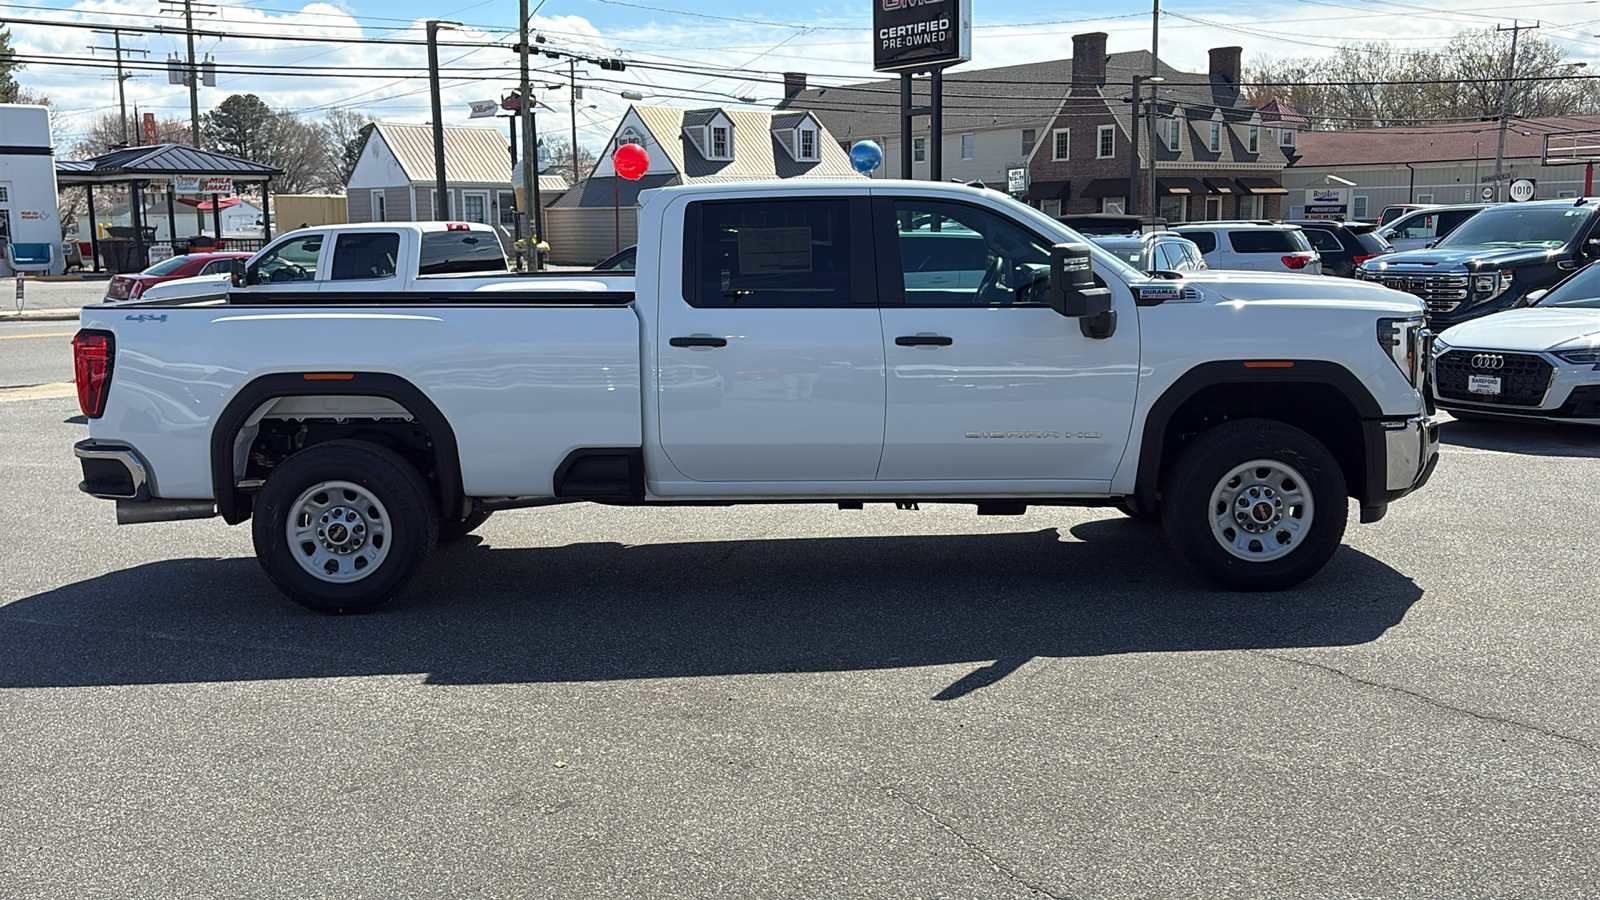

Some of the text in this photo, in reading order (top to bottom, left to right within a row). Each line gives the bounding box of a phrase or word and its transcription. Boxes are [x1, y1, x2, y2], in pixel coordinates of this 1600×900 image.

[880, 19, 949, 39] CERTIFIED
[883, 31, 946, 49] PRE-OWNED
[1513, 186, 1531, 195] 1010
[1386, 280, 1424, 290] GMC
[965, 431, 1102, 439] SIERRA HD
